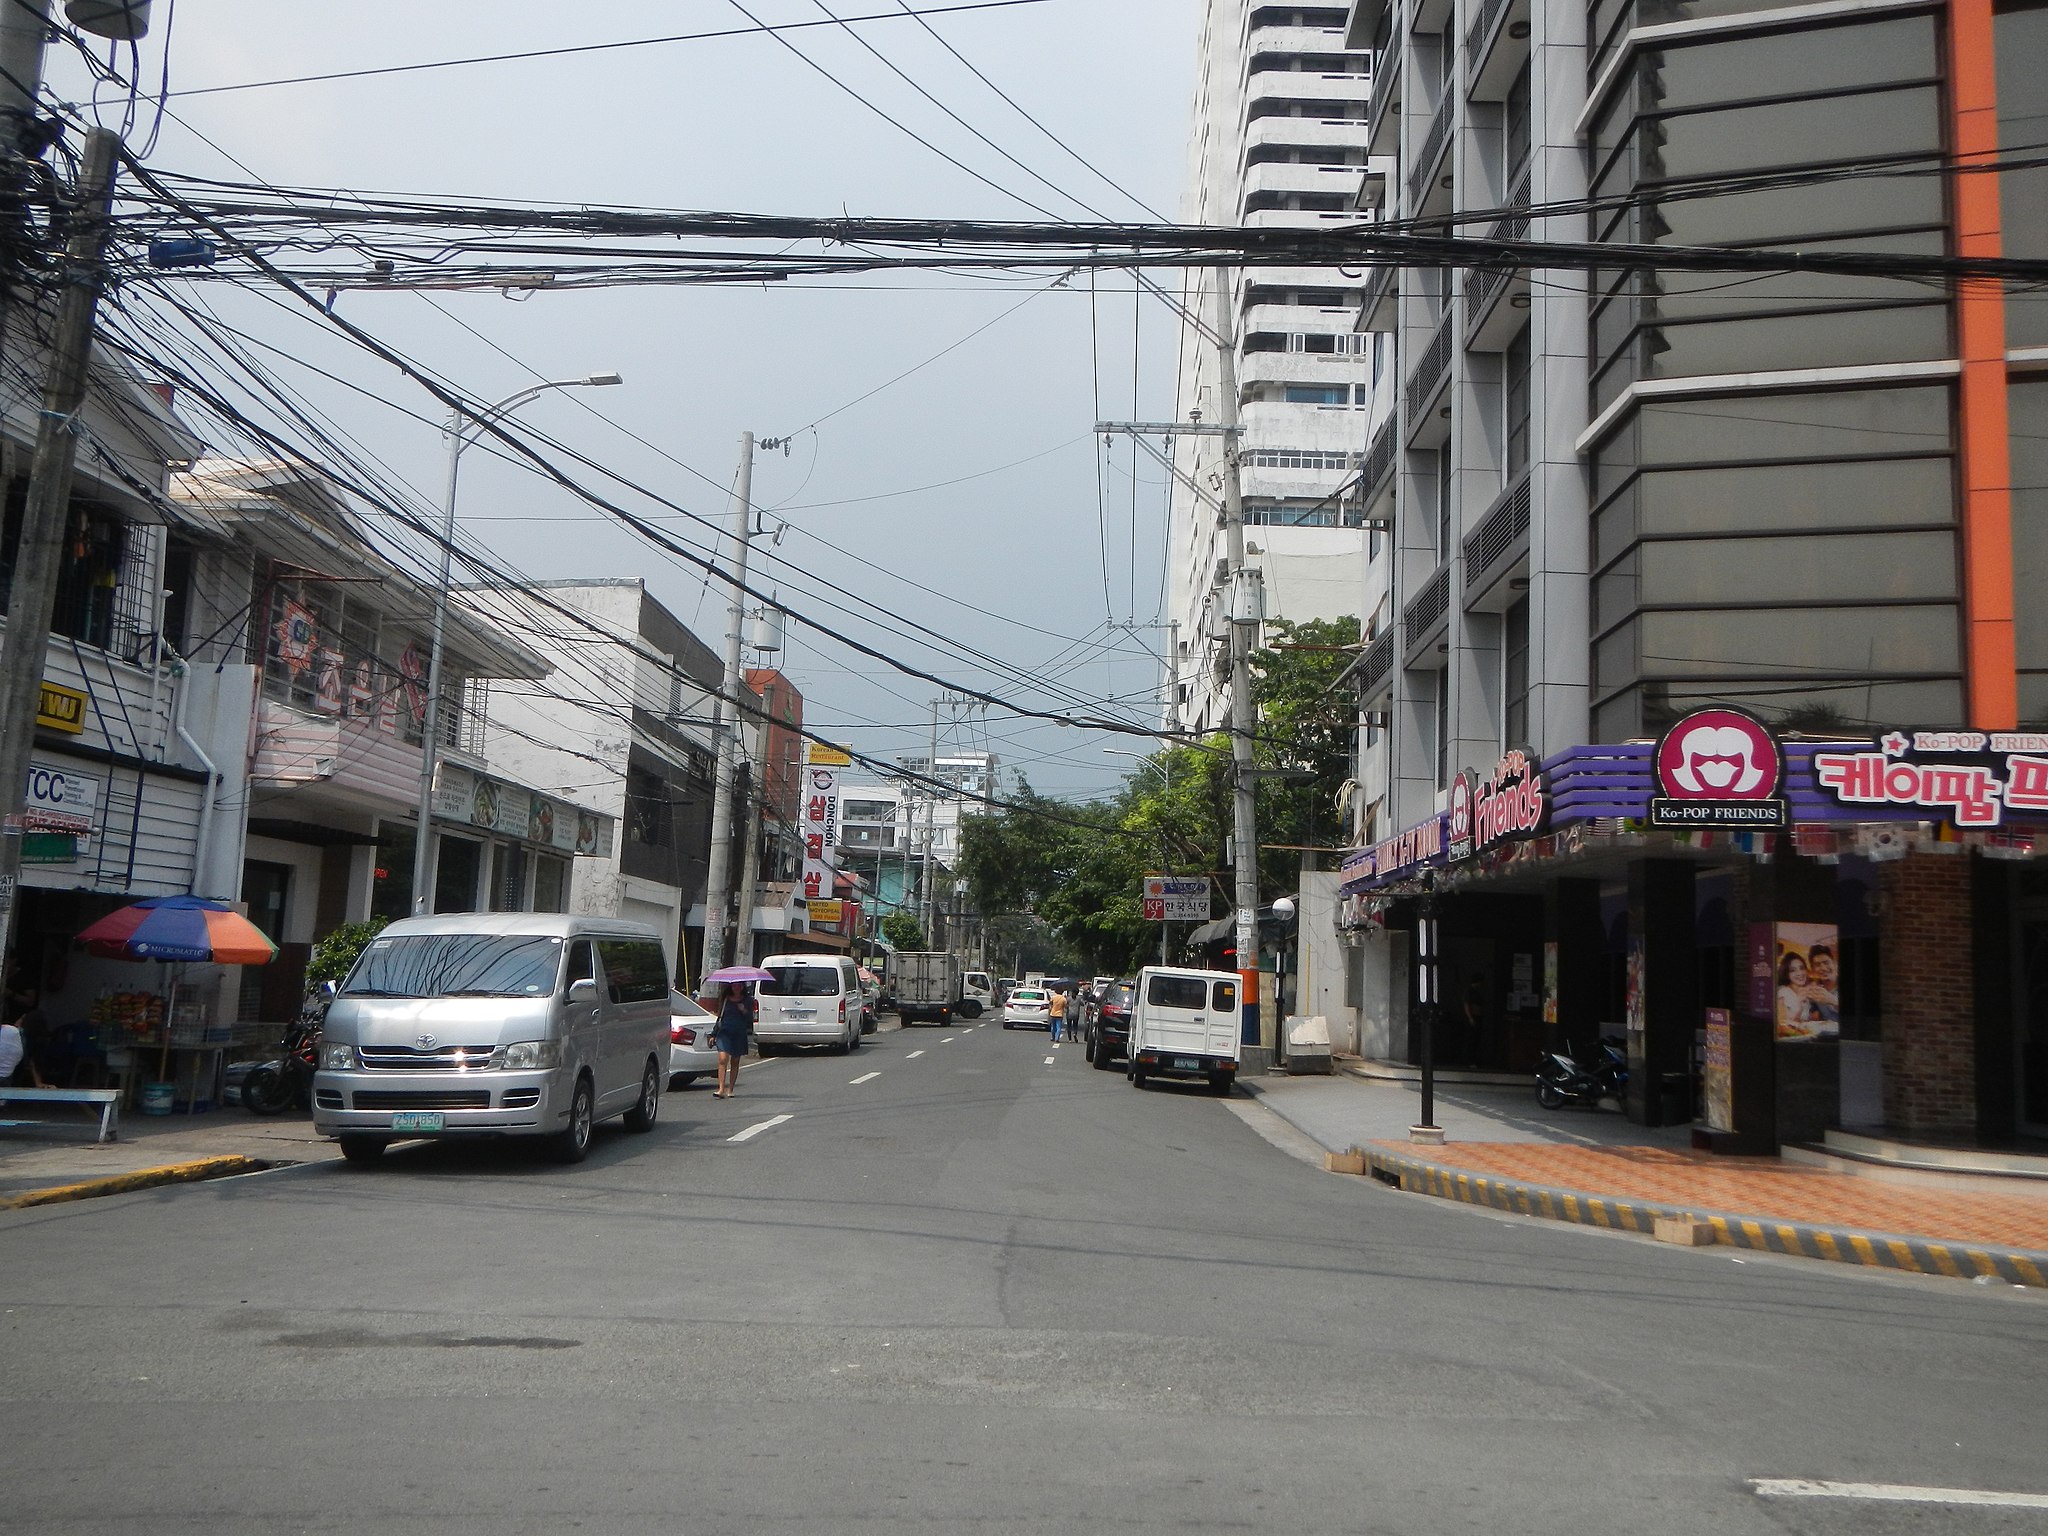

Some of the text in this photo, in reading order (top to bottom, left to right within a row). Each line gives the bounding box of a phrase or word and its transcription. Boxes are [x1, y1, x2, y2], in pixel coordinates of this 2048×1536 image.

[1917, 735, 1984, 749] Ko-POP
[811, 753, 845, 761] Restaurant
[1818, 756, 1999, 823] 케이팝
[1474, 761, 1542, 851] Friends
[1659, 807, 1778, 820] Ko-POP FRIENDS
[824, 795, 836, 848] DONCHON
[1147, 901, 1162, 910] KP
[151, 945, 203, 956] MICROMATIC
